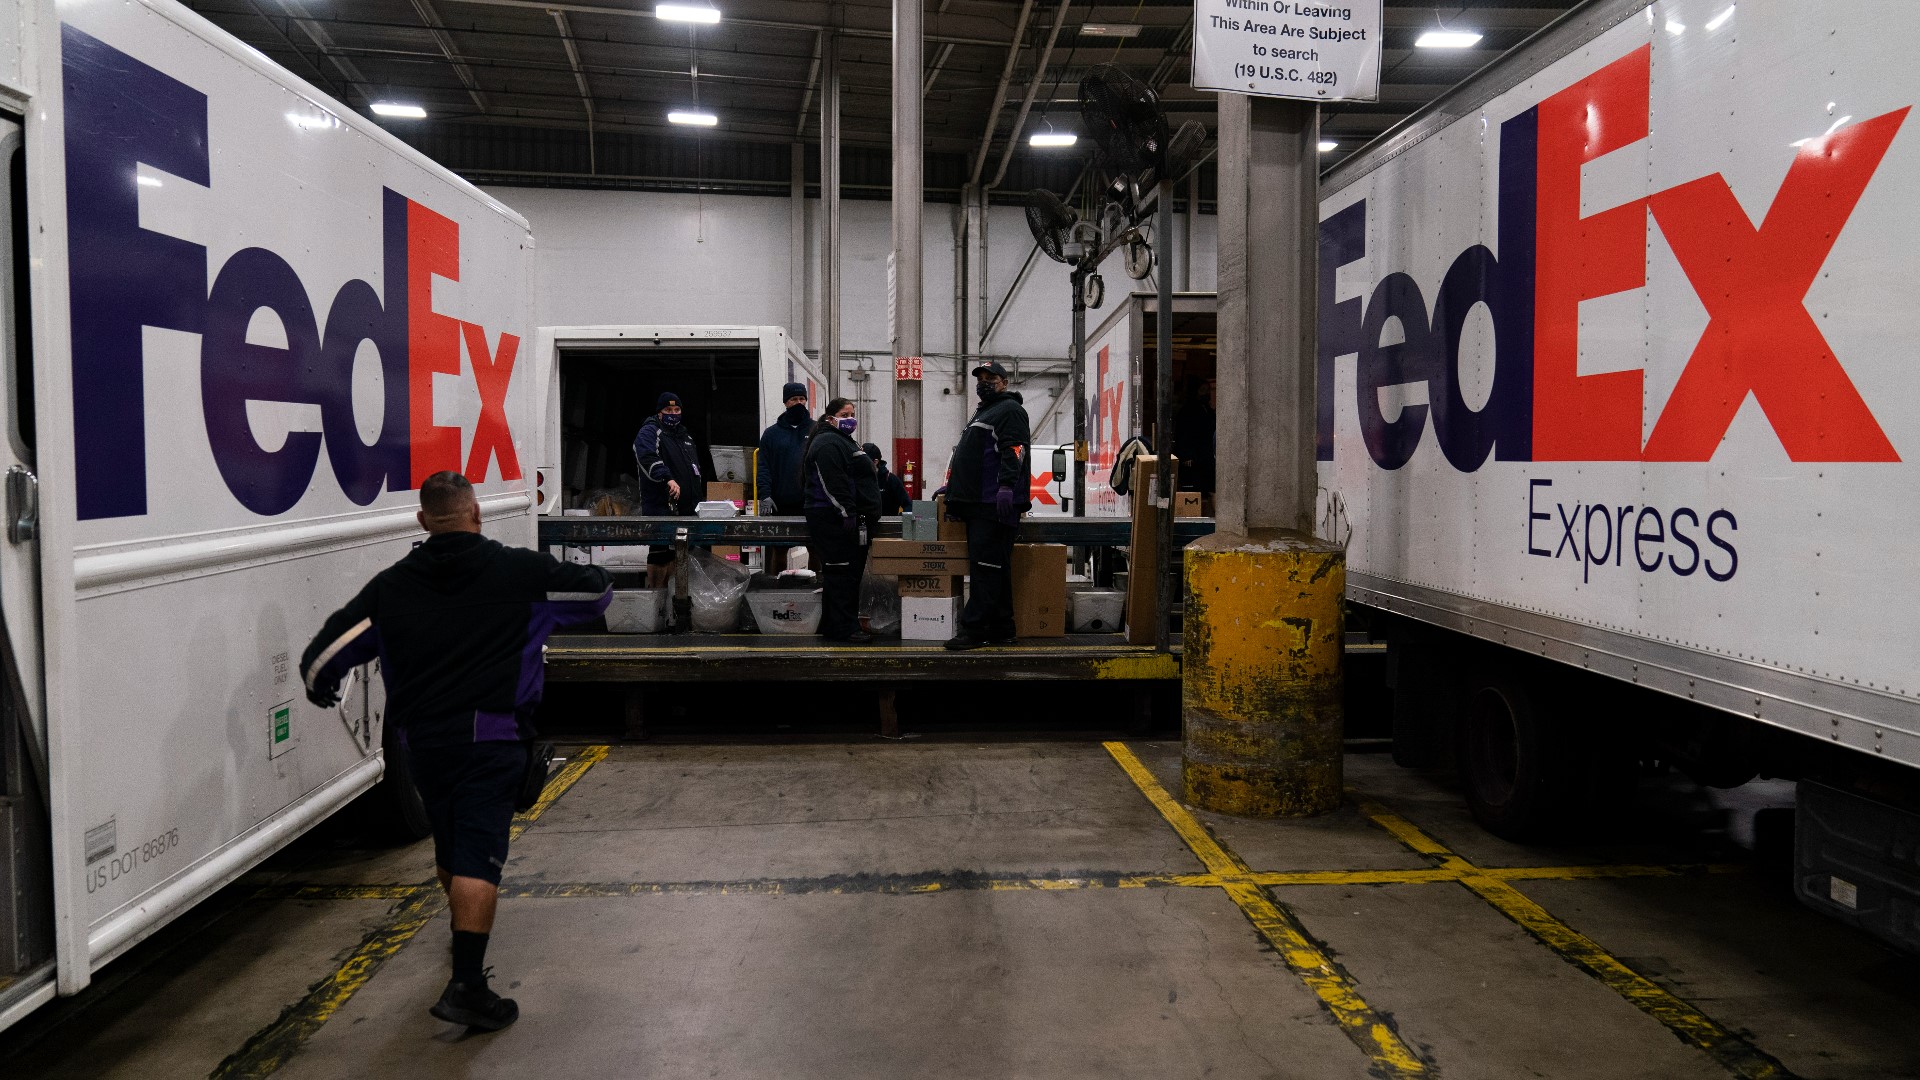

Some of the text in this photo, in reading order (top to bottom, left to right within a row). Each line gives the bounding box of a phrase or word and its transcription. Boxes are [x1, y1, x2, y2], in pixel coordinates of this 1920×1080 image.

[1273, 1, 1290, 14] Or
[1294, 3, 1351, 21] Leaving
[1210, 15, 1367, 42] This Area Are Subject
[1253, 44, 1319, 62] to search
[1235, 63, 1338, 87] (19 U.S.C. 482)
[1318, 43, 1912, 473] FedEx
[61, 22, 523, 520] FedEx
[1528, 479, 1738, 583] Express
[906, 578, 941, 590] STORZ
[773, 610, 802, 621] FedEx
[87, 866, 107, 894] US
[111, 847, 140, 881] DOT
[143, 828, 179, 863] 86876
